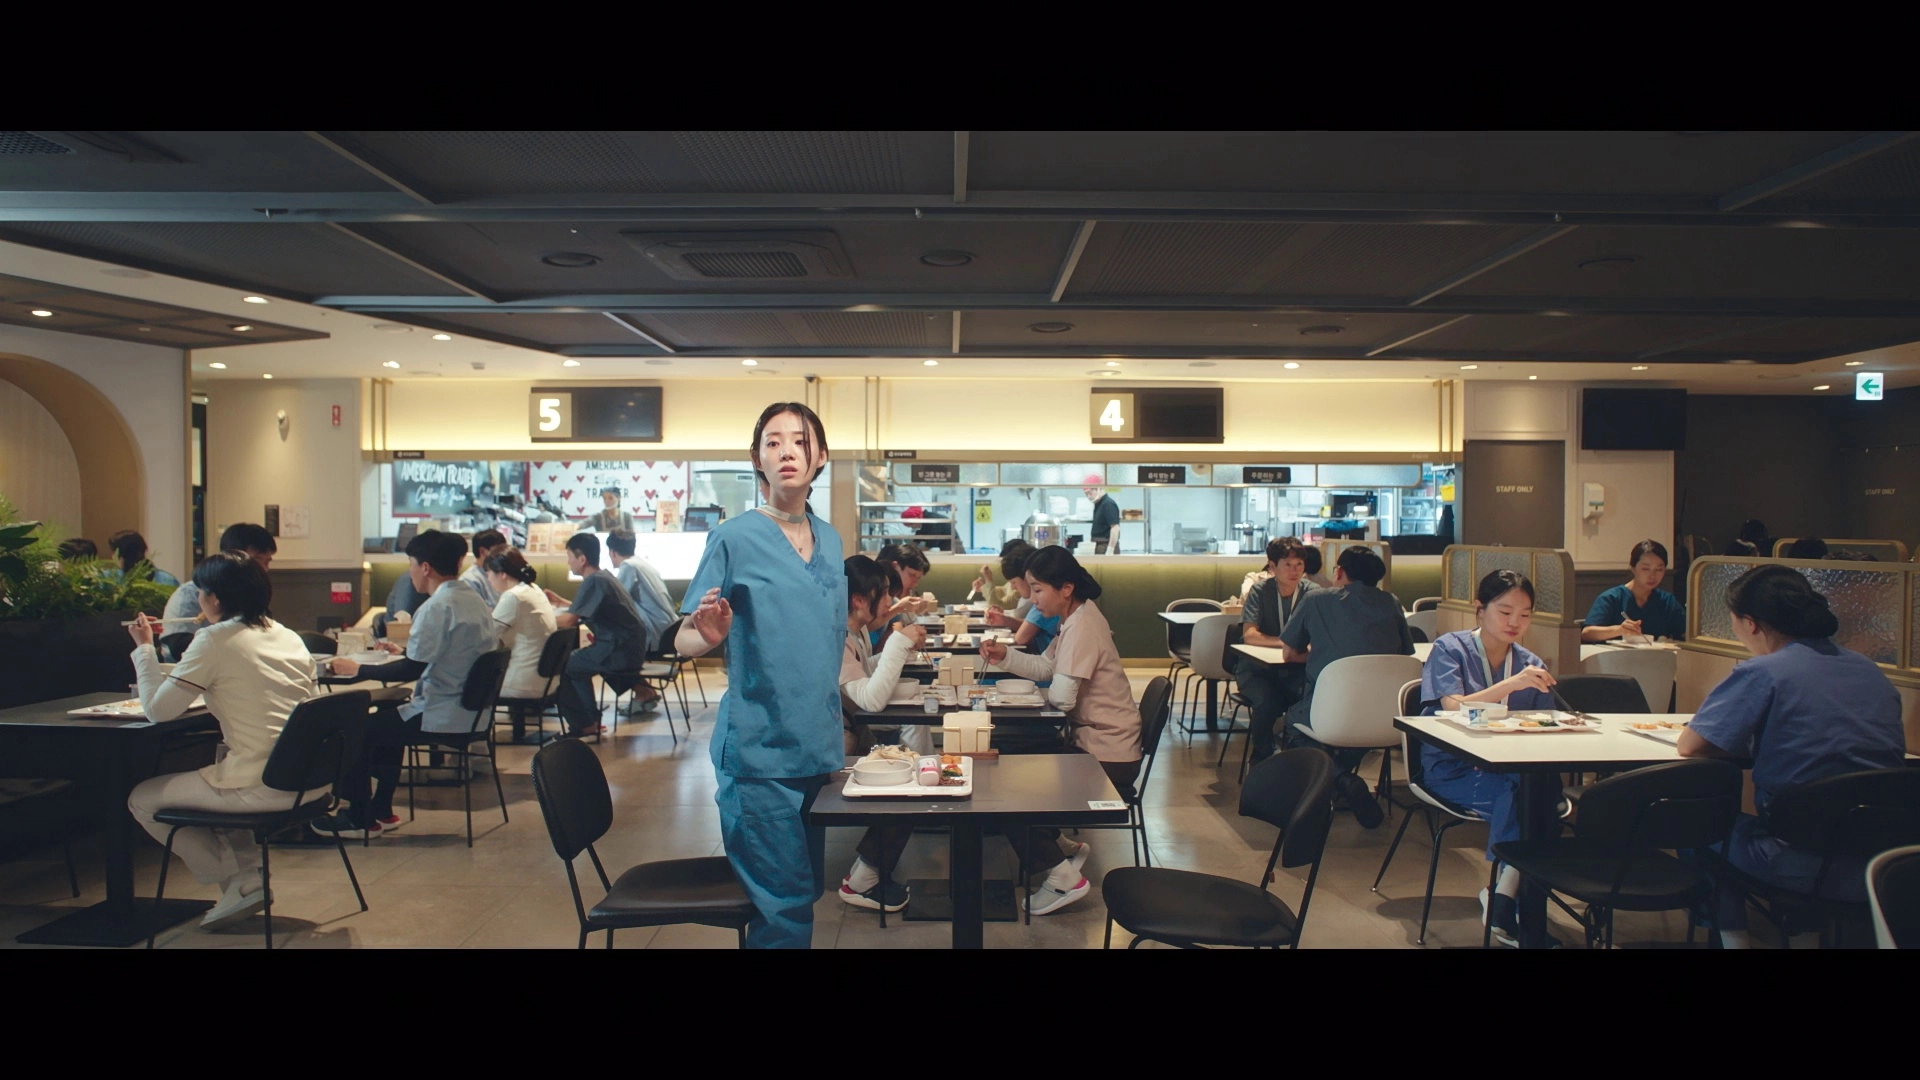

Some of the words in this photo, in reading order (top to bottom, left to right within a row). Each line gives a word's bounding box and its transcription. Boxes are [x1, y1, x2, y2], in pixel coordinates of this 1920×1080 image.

[539, 398, 561, 431] 5
[1099, 399, 1124, 431] 4
[401, 461, 447, 484] AMERICAN
[585, 460, 630, 471] AMERICAN
[1495, 485, 1516, 493] STAFF
[1516, 485, 1534, 493] ONLY
[1865, 488, 1881, 496] STAFF
